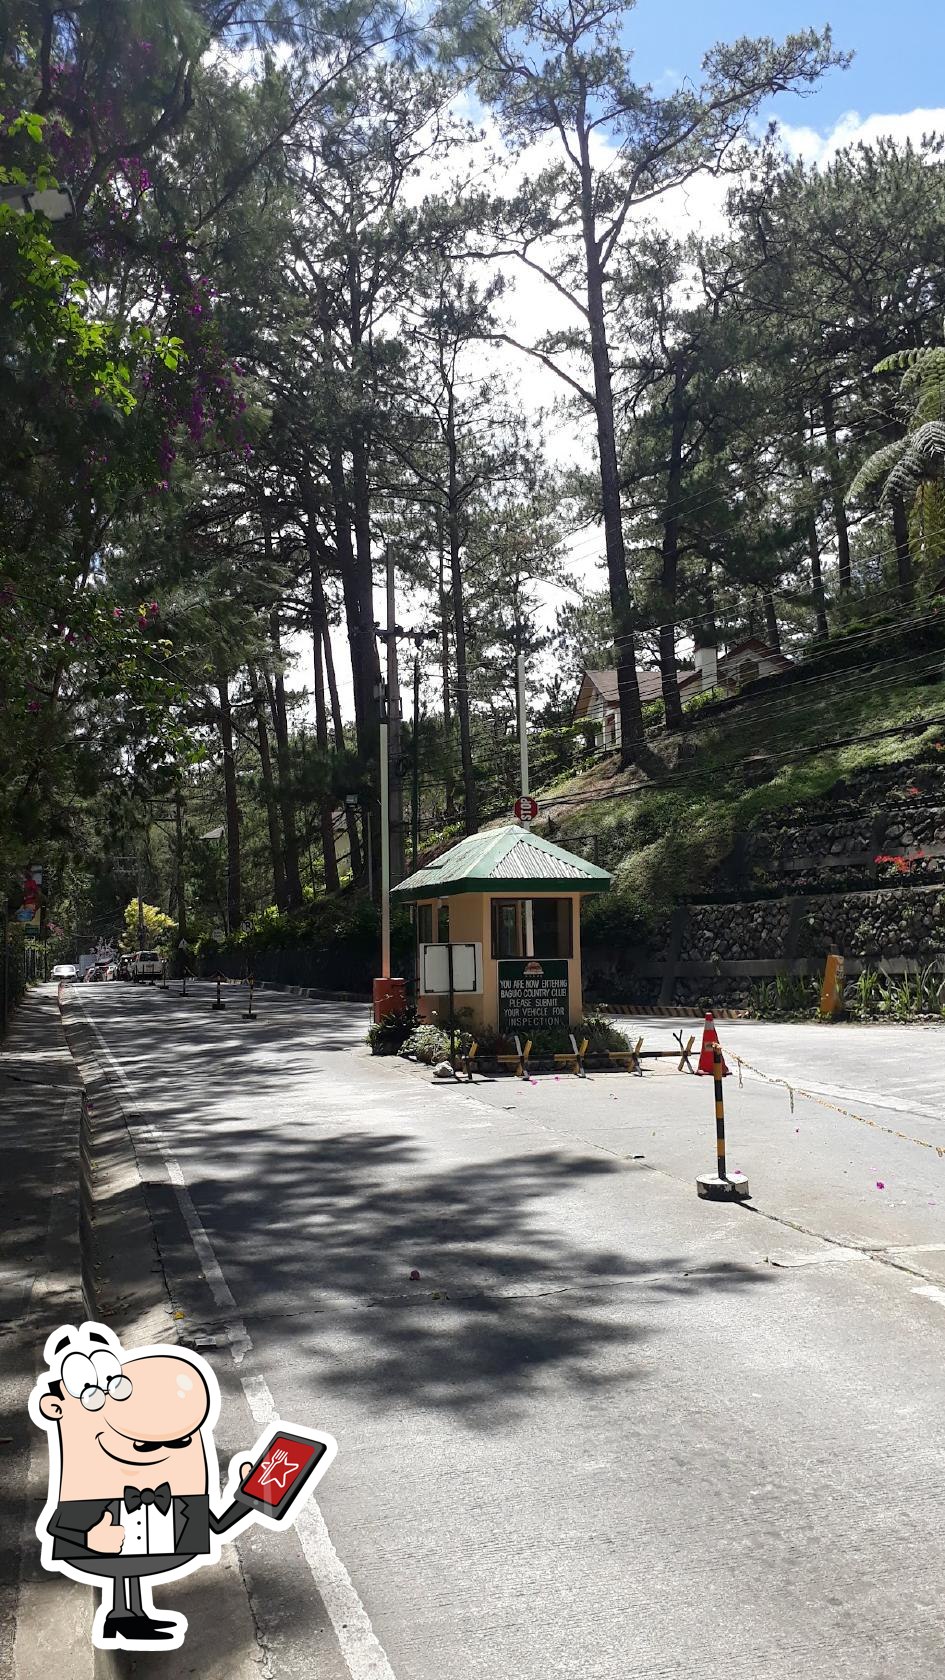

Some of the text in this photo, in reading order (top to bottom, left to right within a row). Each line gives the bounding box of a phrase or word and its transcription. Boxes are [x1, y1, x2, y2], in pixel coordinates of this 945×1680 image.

[520, 798, 532, 820] STOP
[500, 980, 568, 988] YOU ARE NOW ENTERING
[500, 988, 566, 998] BAGUIO COUNTRY CLUB
[509, 998, 557, 1007] PLEASE SUBMIT
[504, 1007, 564, 1017] YOUR VEHICLE FOR
[508, 1017, 560, 1026] INSPECTION
